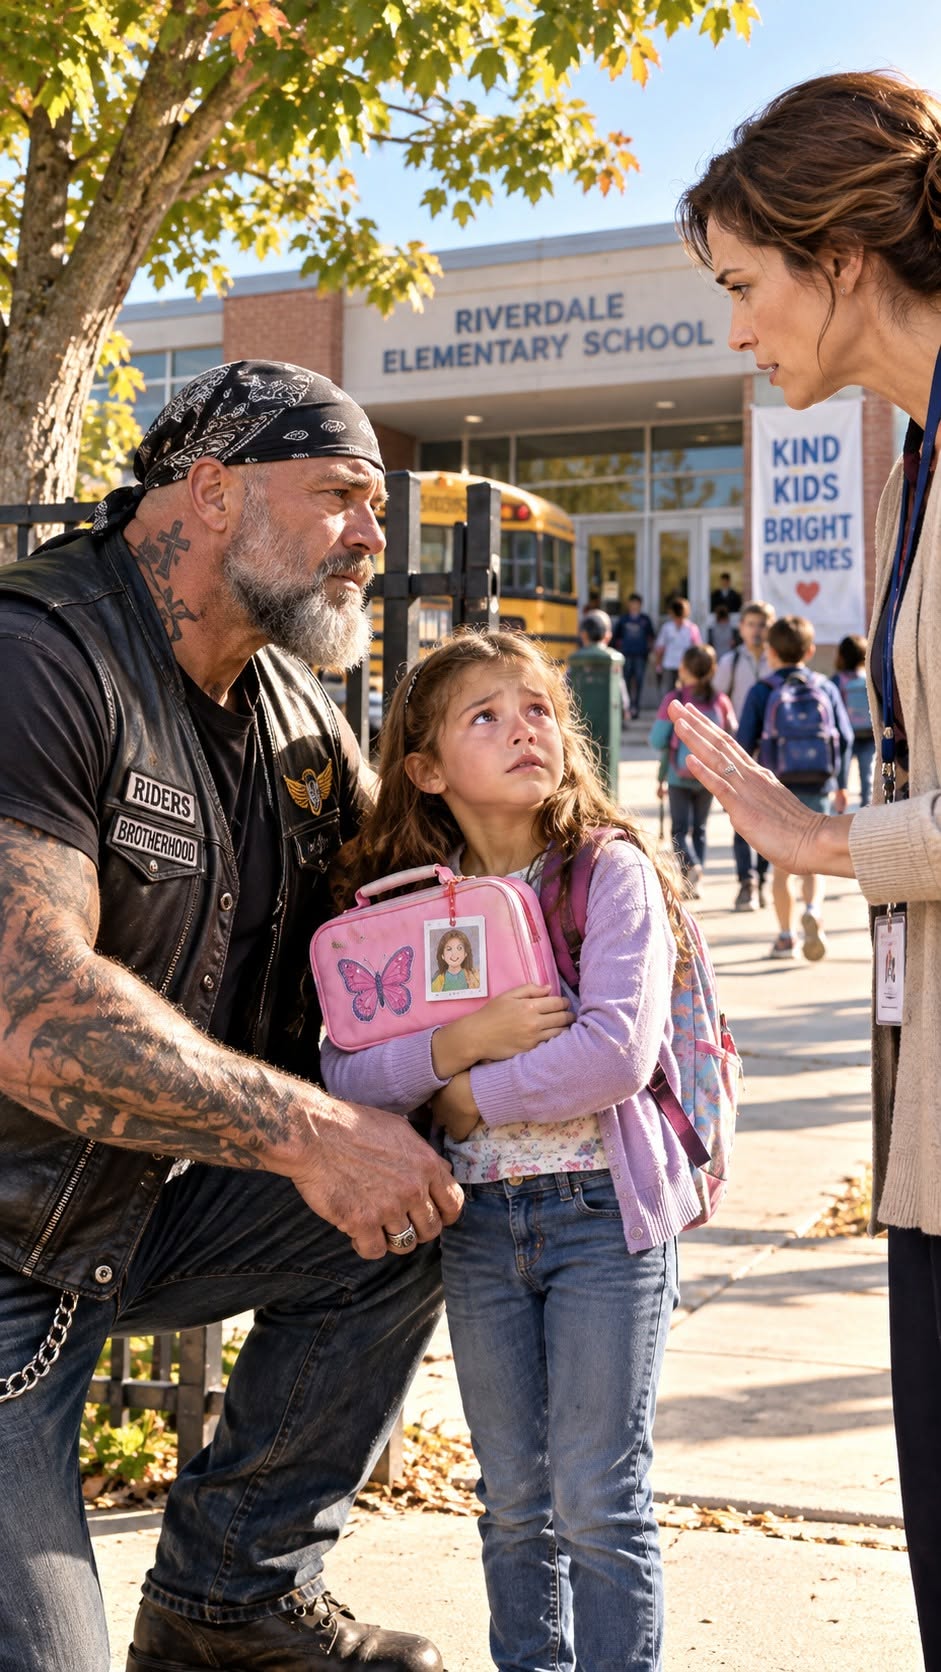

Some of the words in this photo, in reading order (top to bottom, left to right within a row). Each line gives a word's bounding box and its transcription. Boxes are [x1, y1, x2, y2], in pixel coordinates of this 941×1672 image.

[455, 293, 624, 334] RIVERDALE
[383, 334, 568, 374] ELEMENTARY
[583, 321, 714, 357] SCHOOL
[772, 434, 840, 468] KIND
[774, 473, 839, 504] KIDS
[763, 513, 852, 544] BRIGHT
[763, 547, 853, 575] FUTURES
[132, 777, 191, 819] RIDERS
[118, 819, 195, 862] BROTHERHOOD
